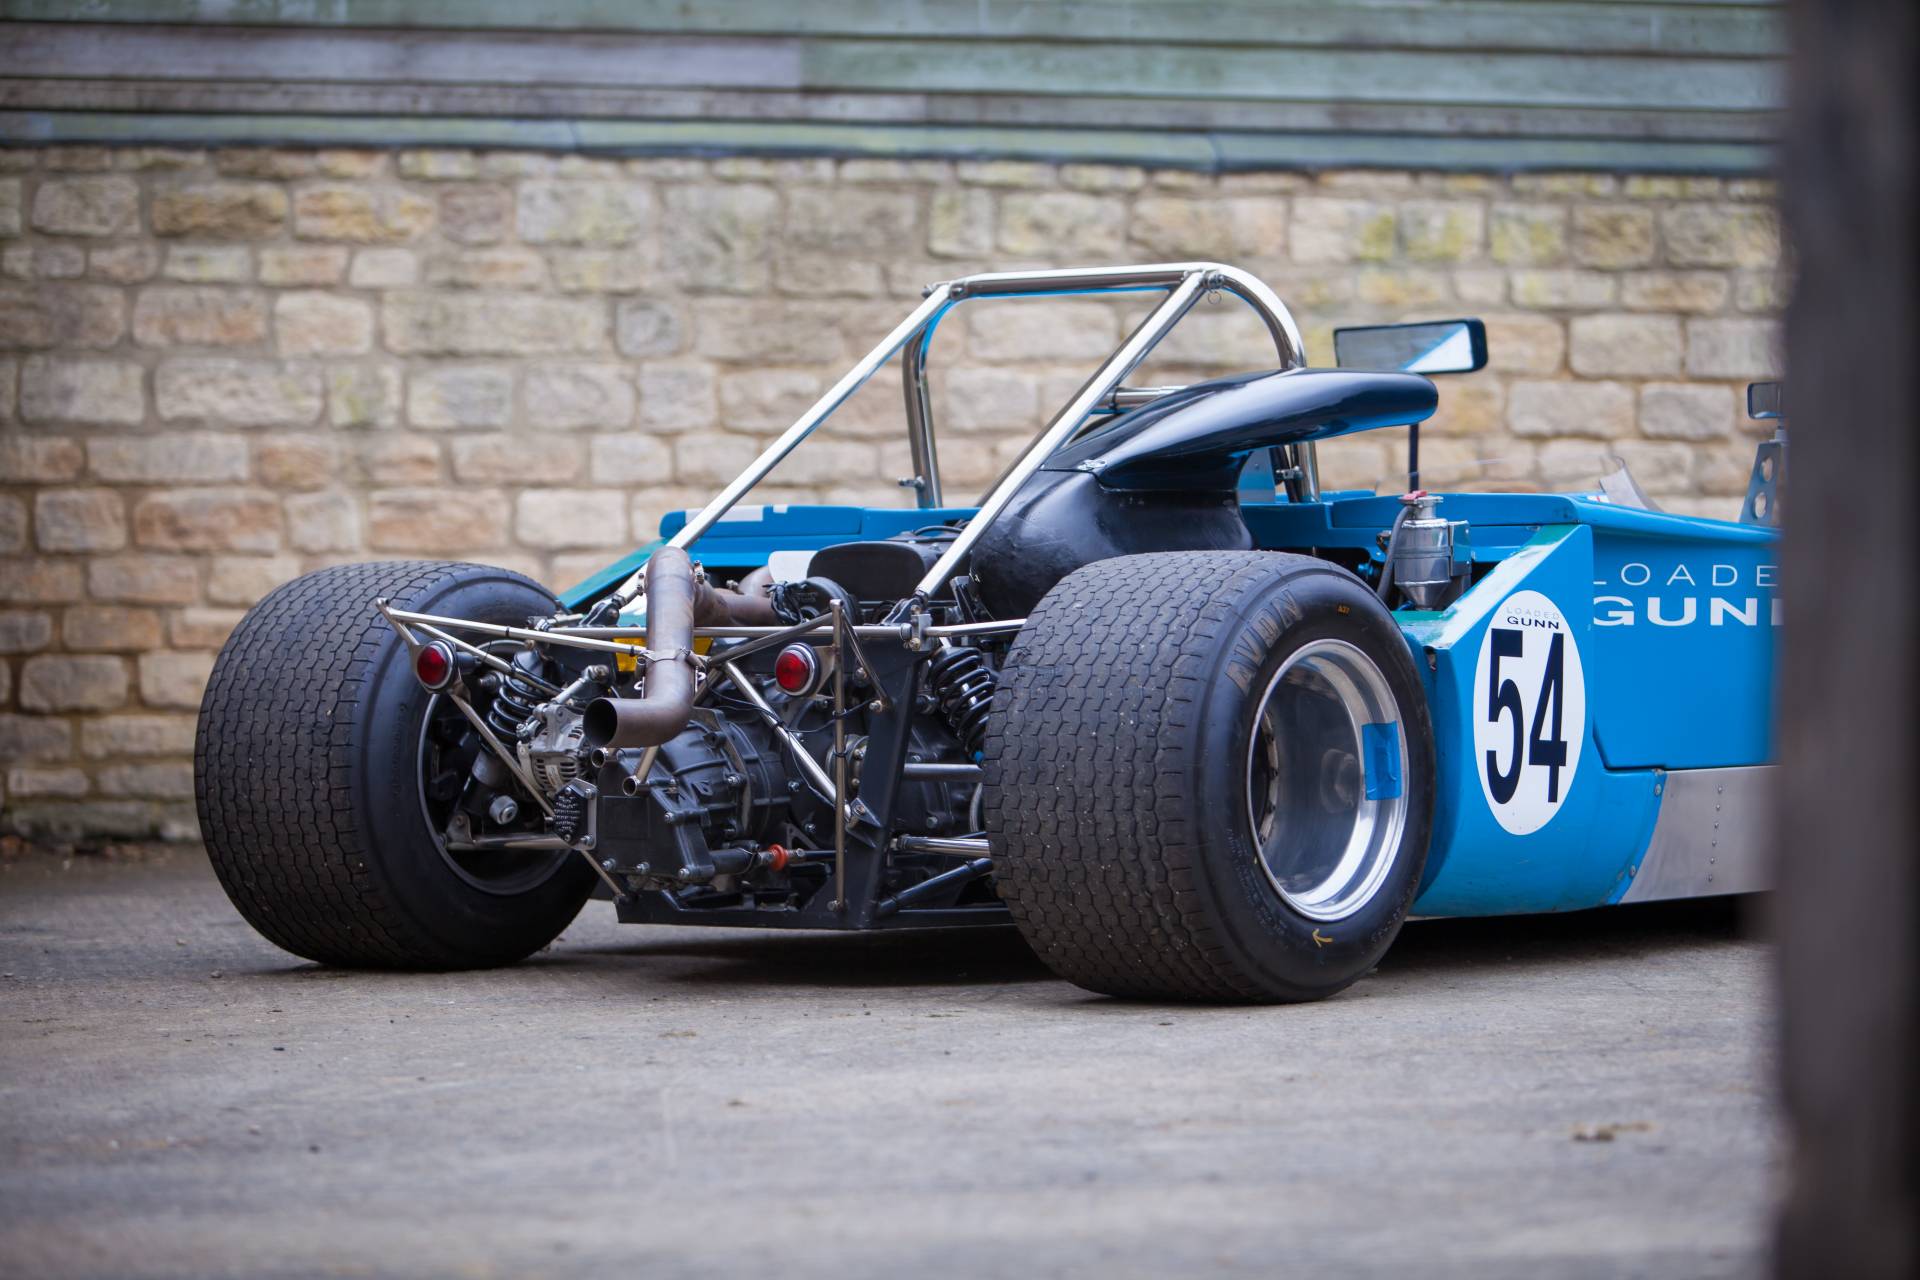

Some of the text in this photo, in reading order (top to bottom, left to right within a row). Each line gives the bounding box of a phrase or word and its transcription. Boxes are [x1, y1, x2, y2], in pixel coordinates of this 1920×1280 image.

[1225, 588, 1303, 697] AVON
[1506, 607, 1559, 619] LOADED
[1507, 616, 1559, 629] GUNN
[1486, 628, 1567, 804] 54
